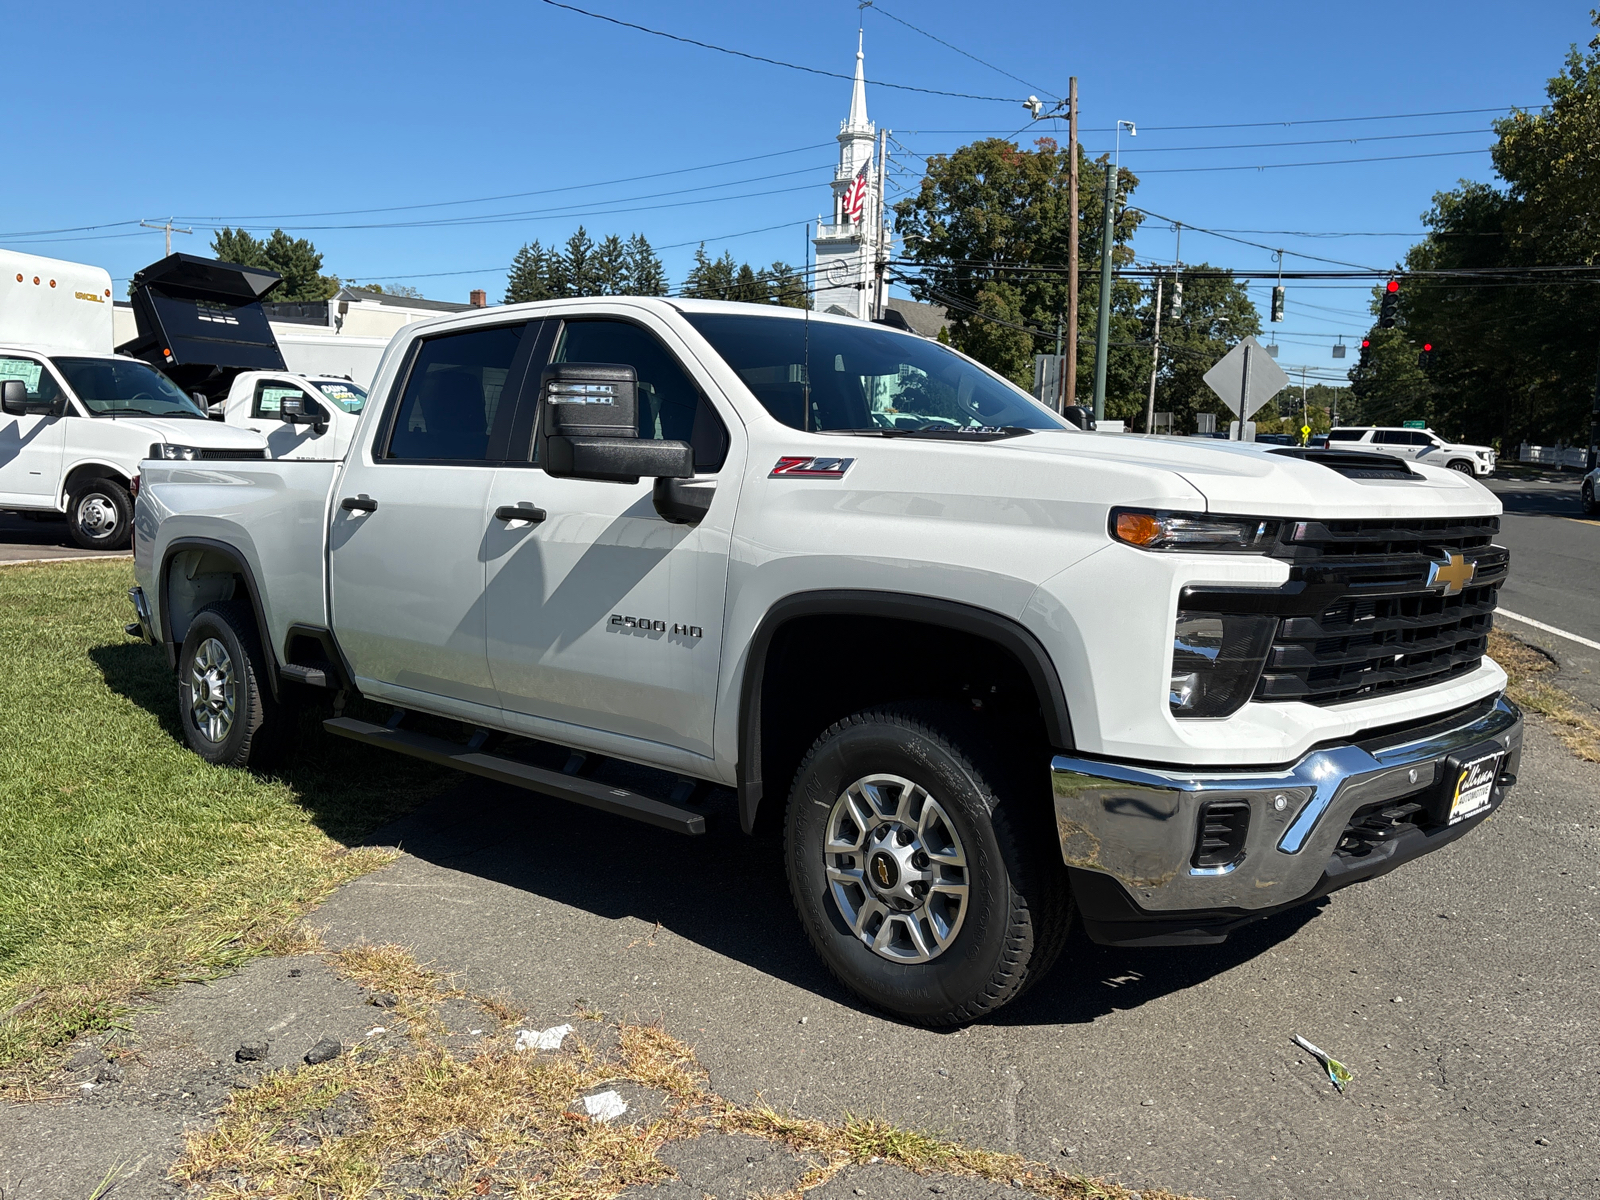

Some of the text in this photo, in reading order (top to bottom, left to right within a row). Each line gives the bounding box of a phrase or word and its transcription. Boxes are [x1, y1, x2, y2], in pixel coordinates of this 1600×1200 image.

[771, 456, 856, 477] Z71
[611, 614, 703, 638] 2500 HD
[1458, 785, 1490, 805] AUTOMOTIVE
